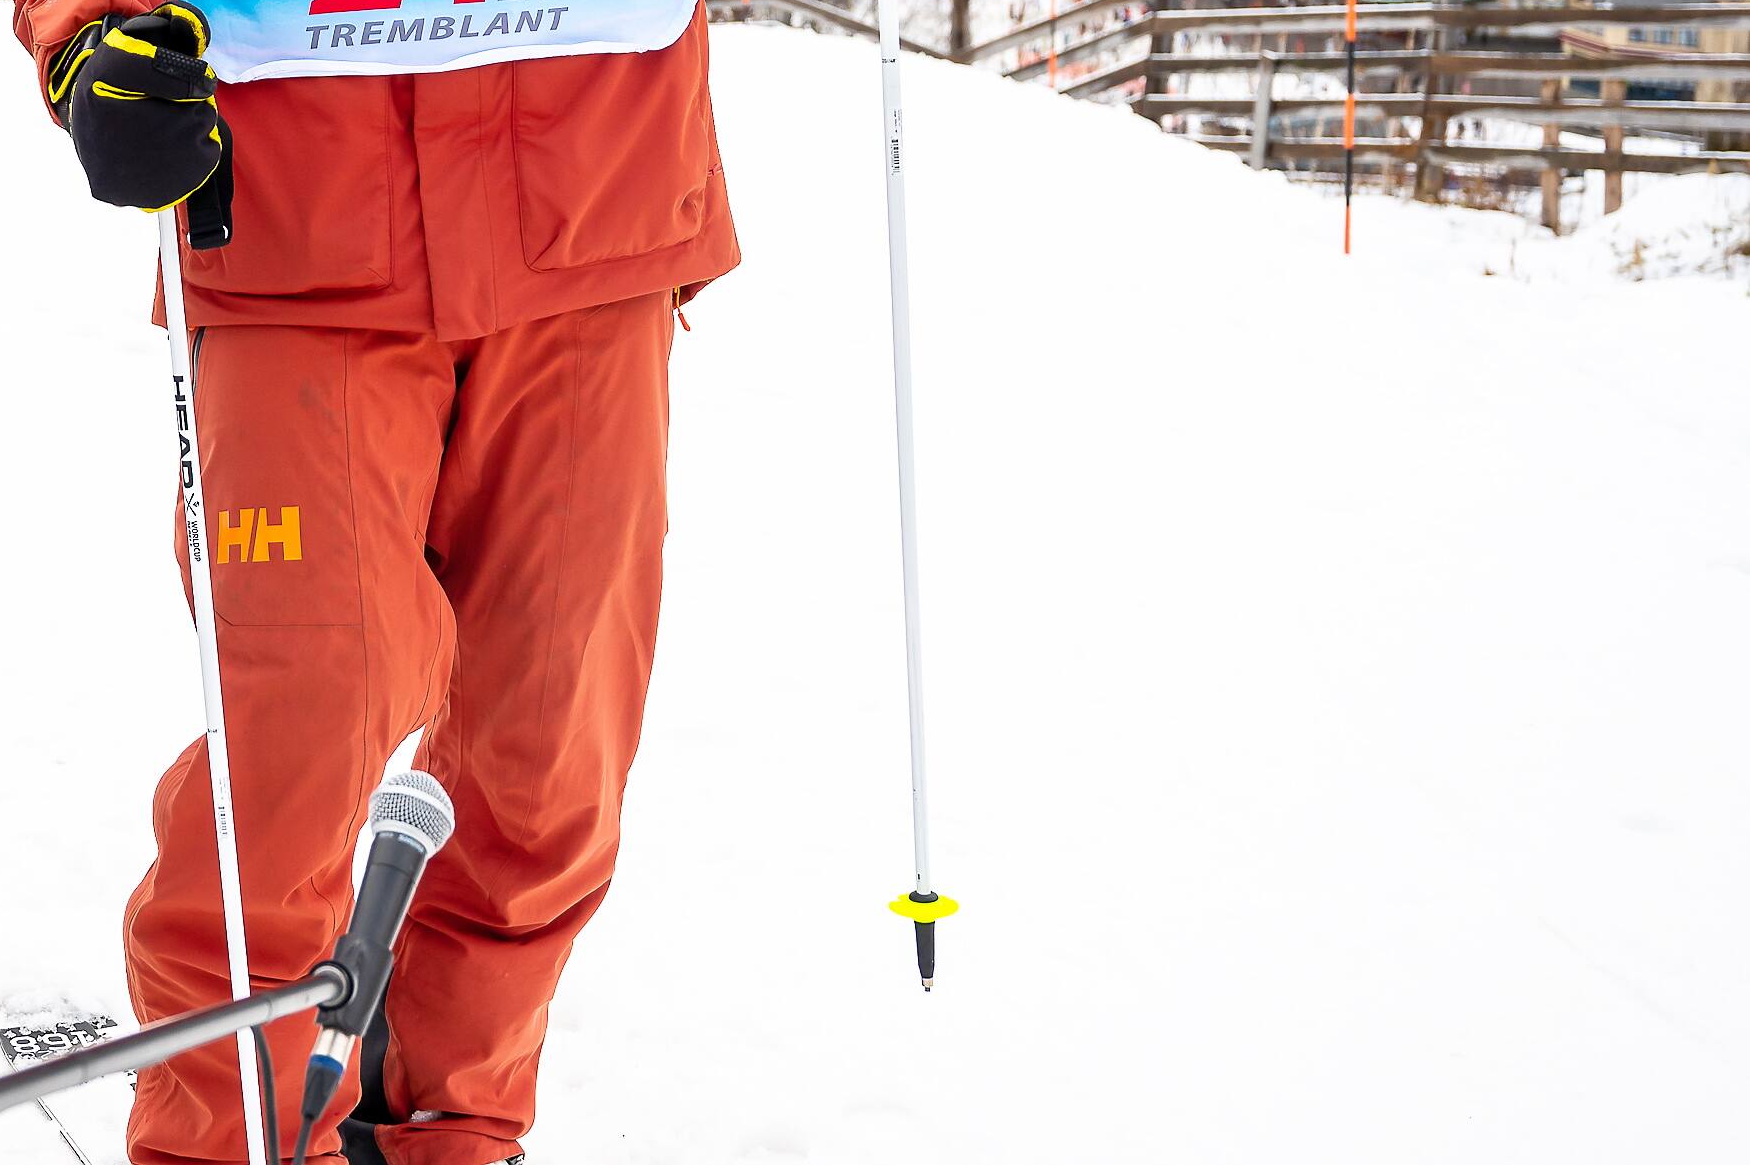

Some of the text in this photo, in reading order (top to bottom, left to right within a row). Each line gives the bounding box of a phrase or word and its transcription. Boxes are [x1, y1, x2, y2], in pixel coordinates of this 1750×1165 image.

[305, 7, 569, 51] TREMBLANT
[173, 375, 194, 490] HEAD
[216, 505, 303, 565] HH
